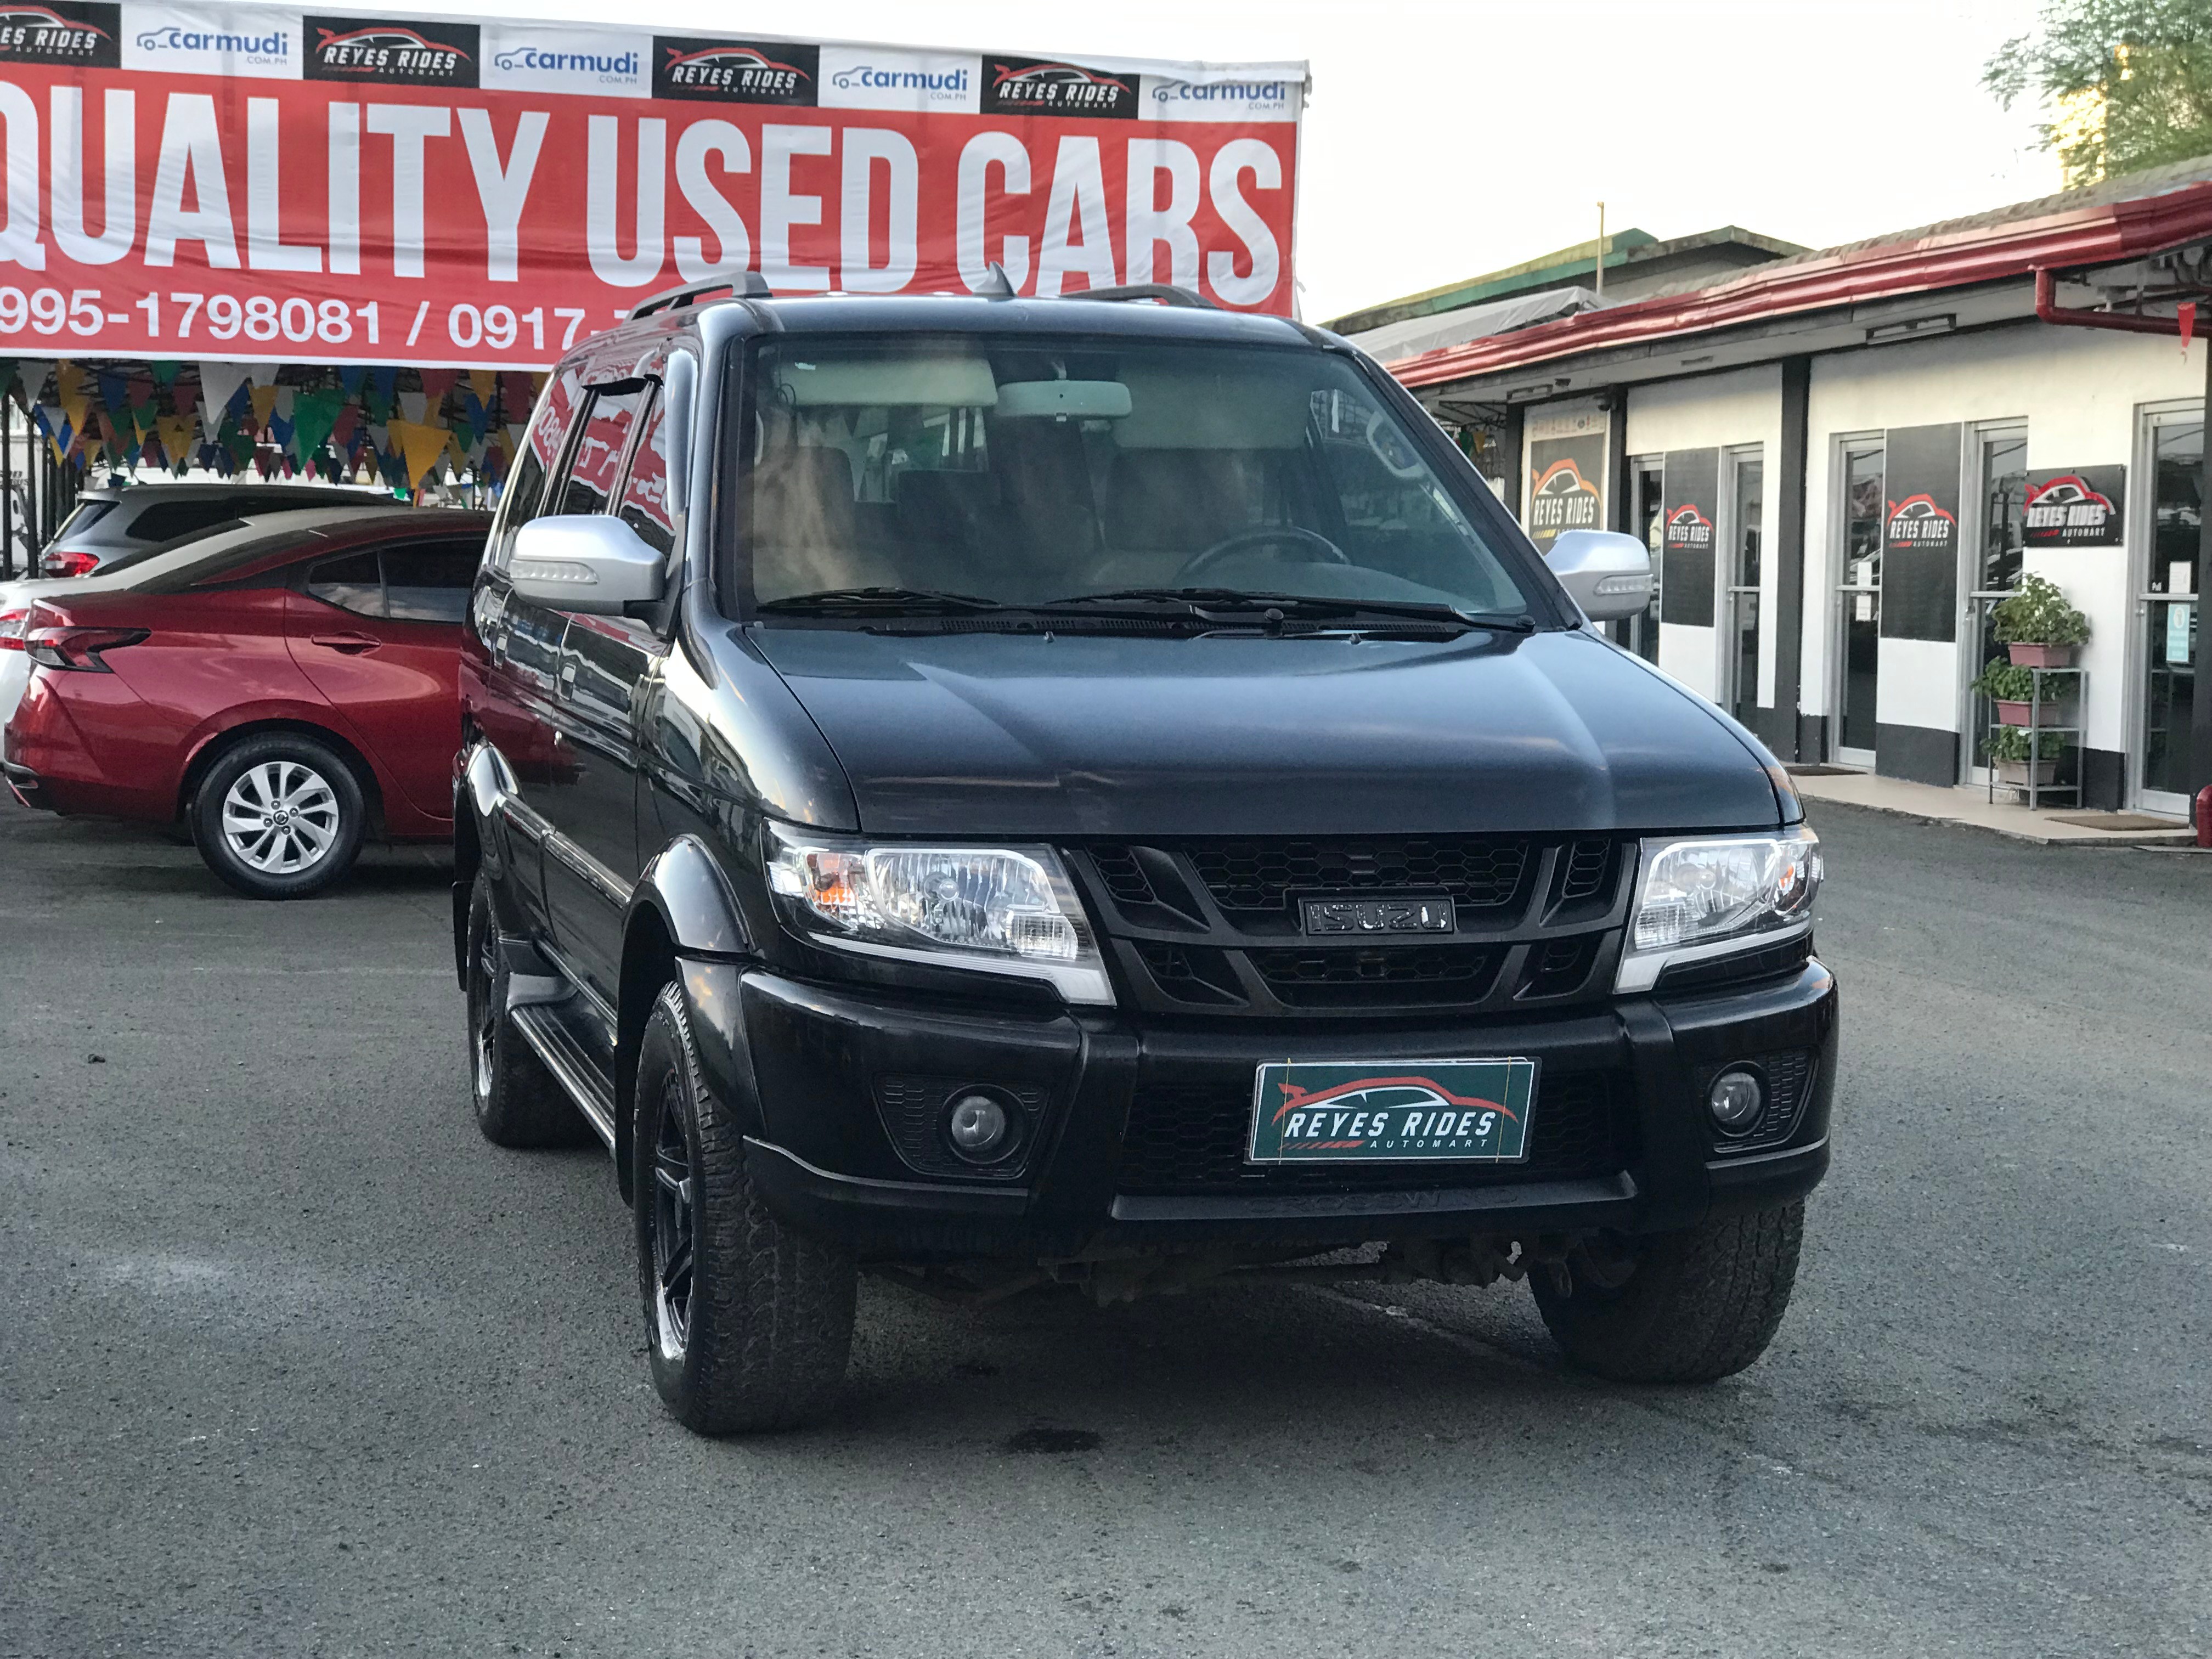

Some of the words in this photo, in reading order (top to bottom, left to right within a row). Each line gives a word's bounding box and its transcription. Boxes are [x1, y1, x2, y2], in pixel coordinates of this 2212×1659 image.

[35, 29, 98, 49] RIDES
[169, 32, 288, 55] carmudi
[323, 46, 390, 67] REYES
[397, 49, 457, 70] RIDES
[525, 52, 639, 75] carmudi
[672, 66, 734, 86] REYES
[741, 70, 797, 89] RIDES
[861, 69, 968, 91] carmudi
[999, 82, 1058, 100] REYES
[1065, 84, 1119, 102] RIDES
[1180, 82, 1285, 100] carmudi
[586, 114, 919, 293] USED
[956, 131, 1282, 306] CARS
[0, 287, 379, 345] 995-1798081
[406, 301, 430, 347] /
[1533, 498, 1563, 526] REYES
[1565, 496, 1595, 524] RIDES
[2026, 506, 2068, 528] REYES
[2067, 504, 2107, 527] RIDES
[1668, 525, 1689, 541] REYES
[1690, 526, 1710, 542] RIDES
[1889, 520, 1919, 539] REYES
[1921, 519, 1950, 539] RIDES
[2062, 527, 2105, 537] AUTOMART
[1310, 904, 1448, 931] ISUZU
[1284, 1112, 1389, 1137] REYES
[1401, 1111, 1496, 1137] RIDES
[1370, 1139, 1488, 1149] AUTOMART
